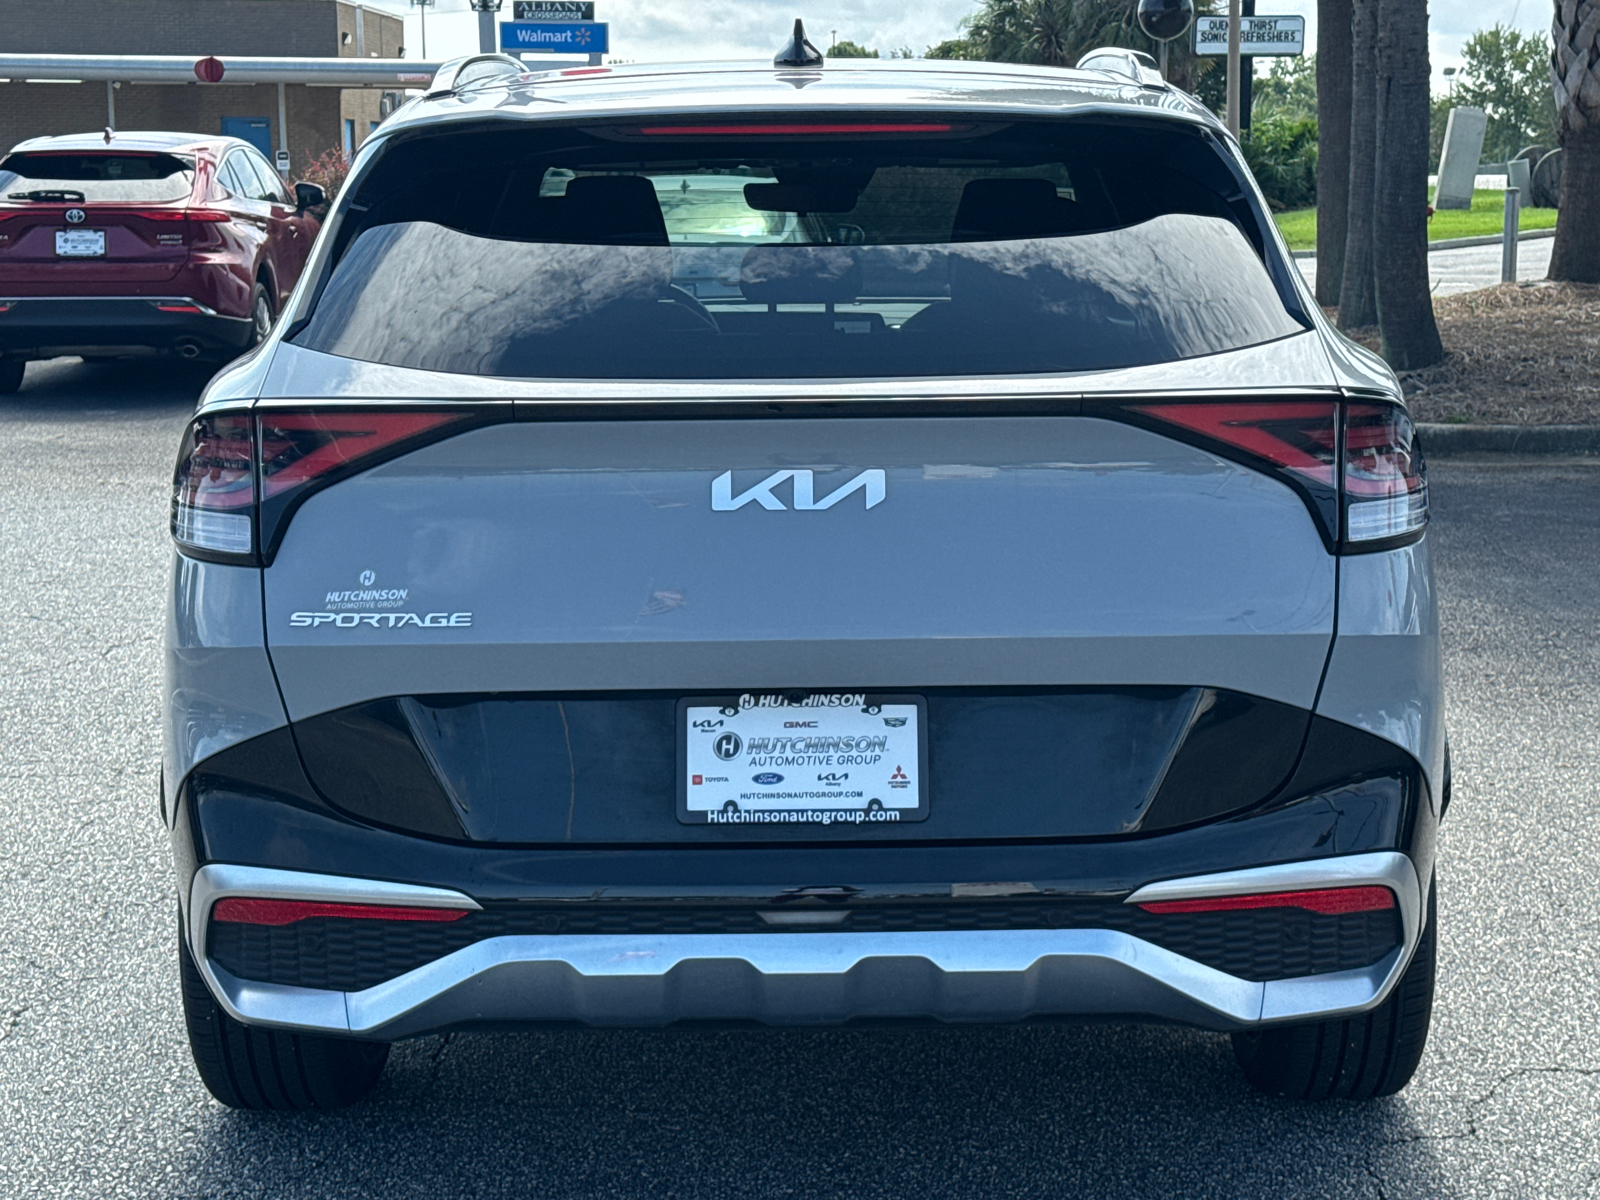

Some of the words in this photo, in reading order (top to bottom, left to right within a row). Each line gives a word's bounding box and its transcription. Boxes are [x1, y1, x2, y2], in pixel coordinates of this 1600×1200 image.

[518, 2, 589, 11] ALBANY
[1208, 20, 1236, 31] QUEN
[1249, 20, 1278, 31] THIRST
[516, 29, 573, 42] Walmart
[1200, 31, 1228, 42] SONIC
[1240, 31, 1296, 42] REFRESHERS
[711, 469, 886, 511] KIA
[325, 589, 409, 602] HUTCHINSON
[326, 601, 376, 610] AUTOMOTIVE
[377, 600, 404, 609] GROUP
[289, 612, 473, 628] SPORTAGE
[758, 694, 866, 708] HUHINSON
[746, 736, 887, 754] HUTCHINSON
[748, 755, 834, 768] AUTOMOTIVE
[836, 754, 882, 766] GROUP
[757, 773, 779, 784] Ford
[740, 791, 863, 799] HUTCHINSONAUTOGROUP.COM
[707, 808, 900, 824] Hutchinsonautogroup.com
